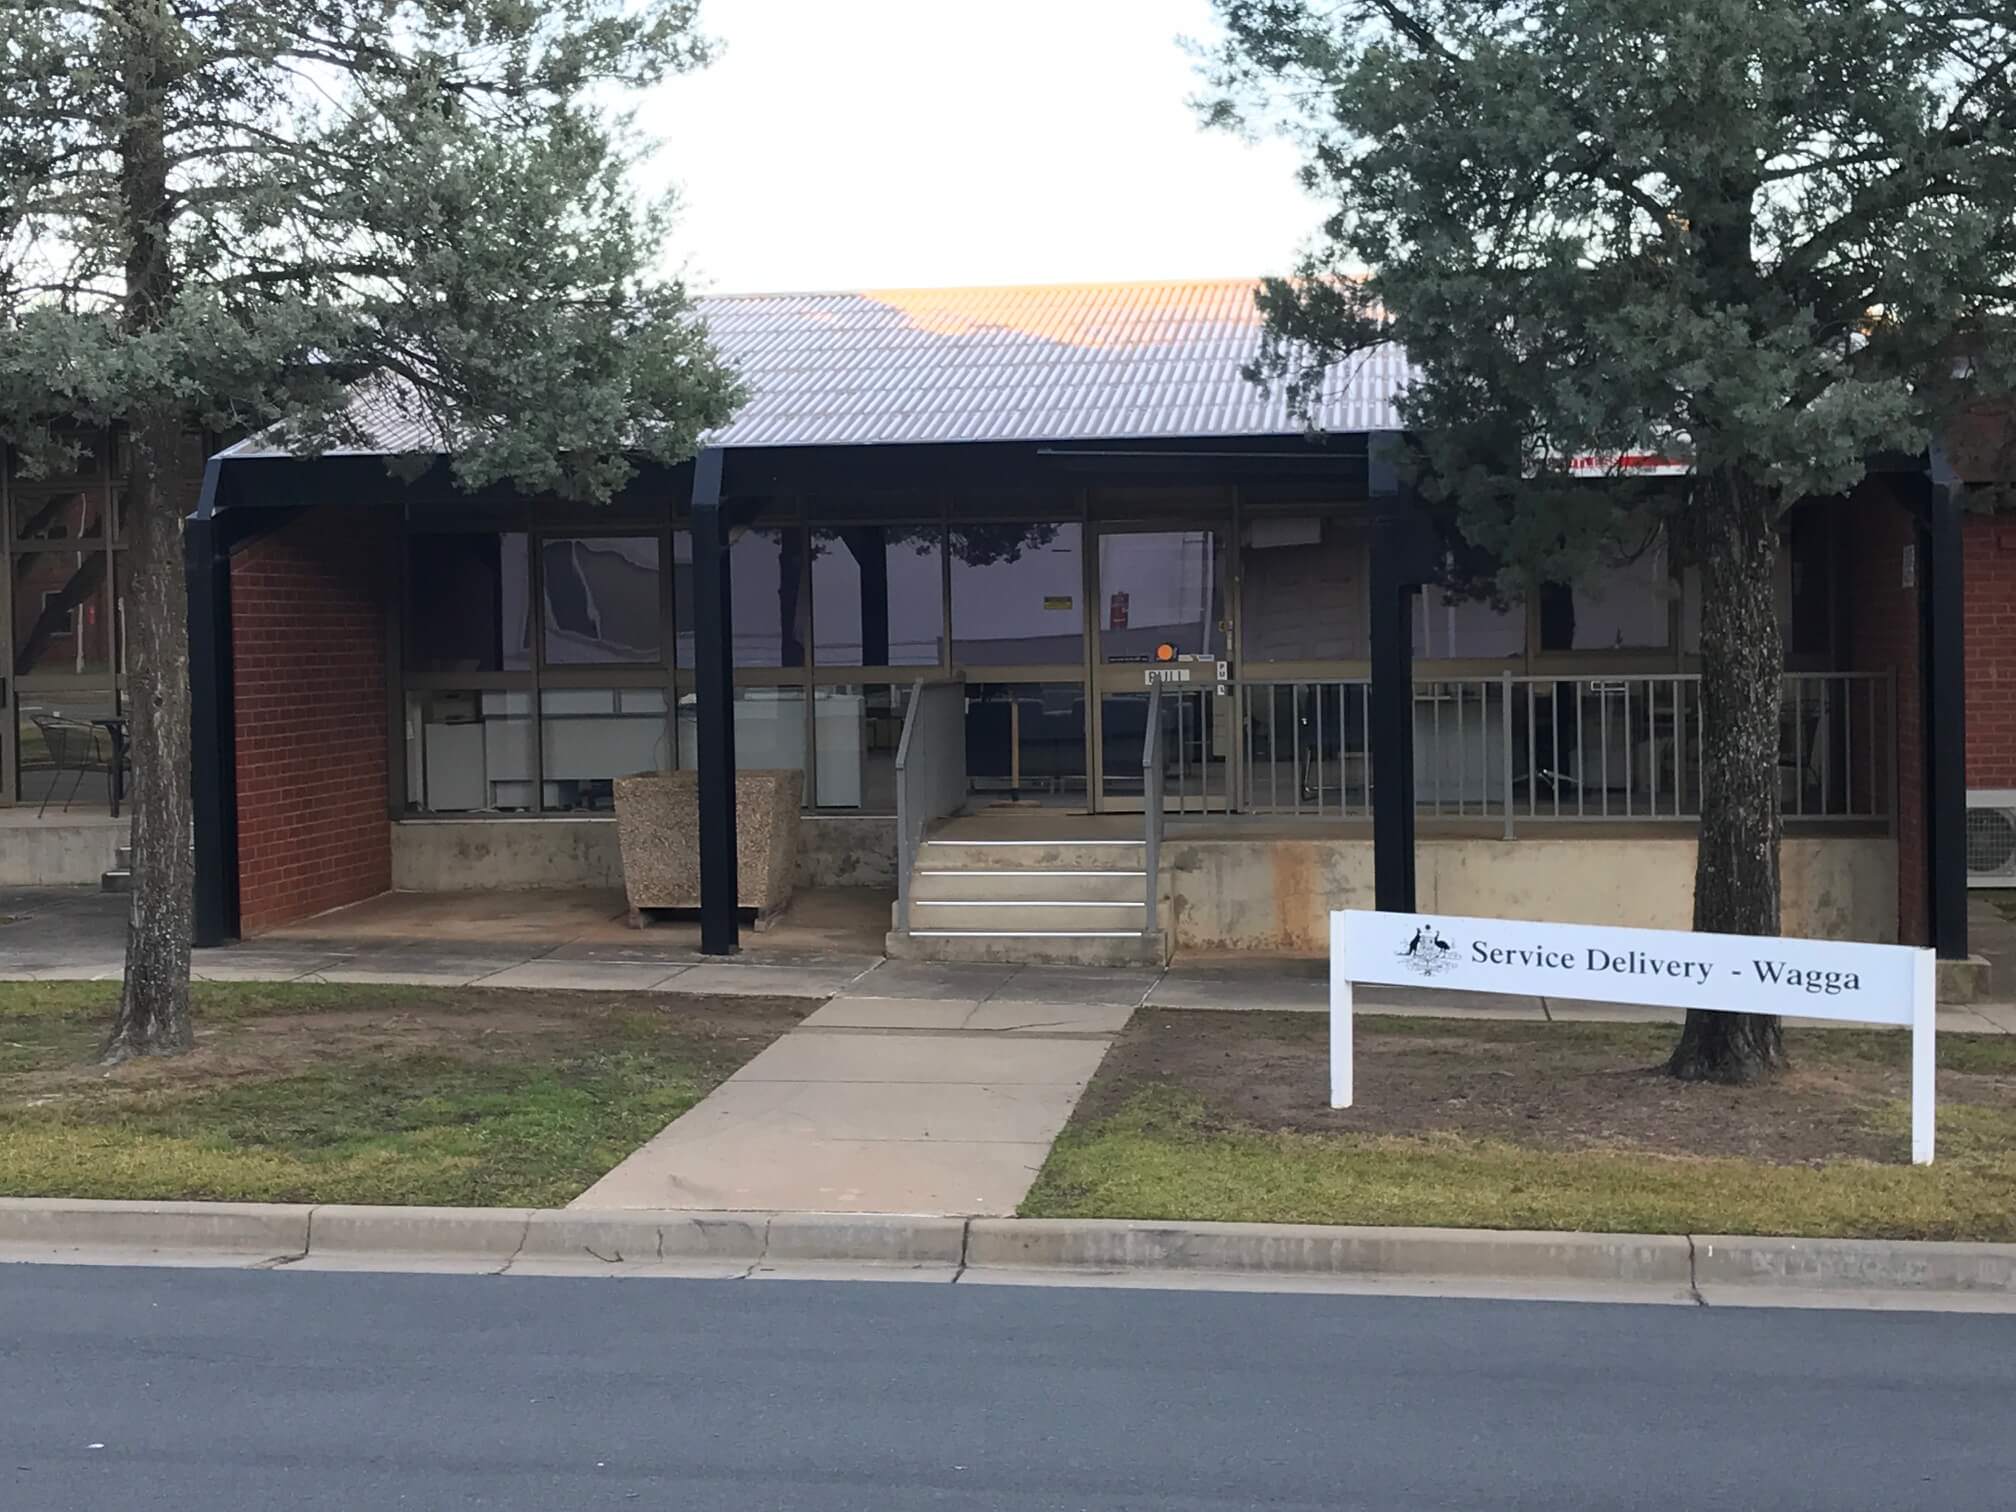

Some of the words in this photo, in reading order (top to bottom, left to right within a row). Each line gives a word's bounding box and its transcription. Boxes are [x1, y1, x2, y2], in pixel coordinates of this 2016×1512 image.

[1471, 940, 1575, 969] Service
[1586, 948, 1714, 985] Delivery
[1752, 959, 1862, 995] Wagga
